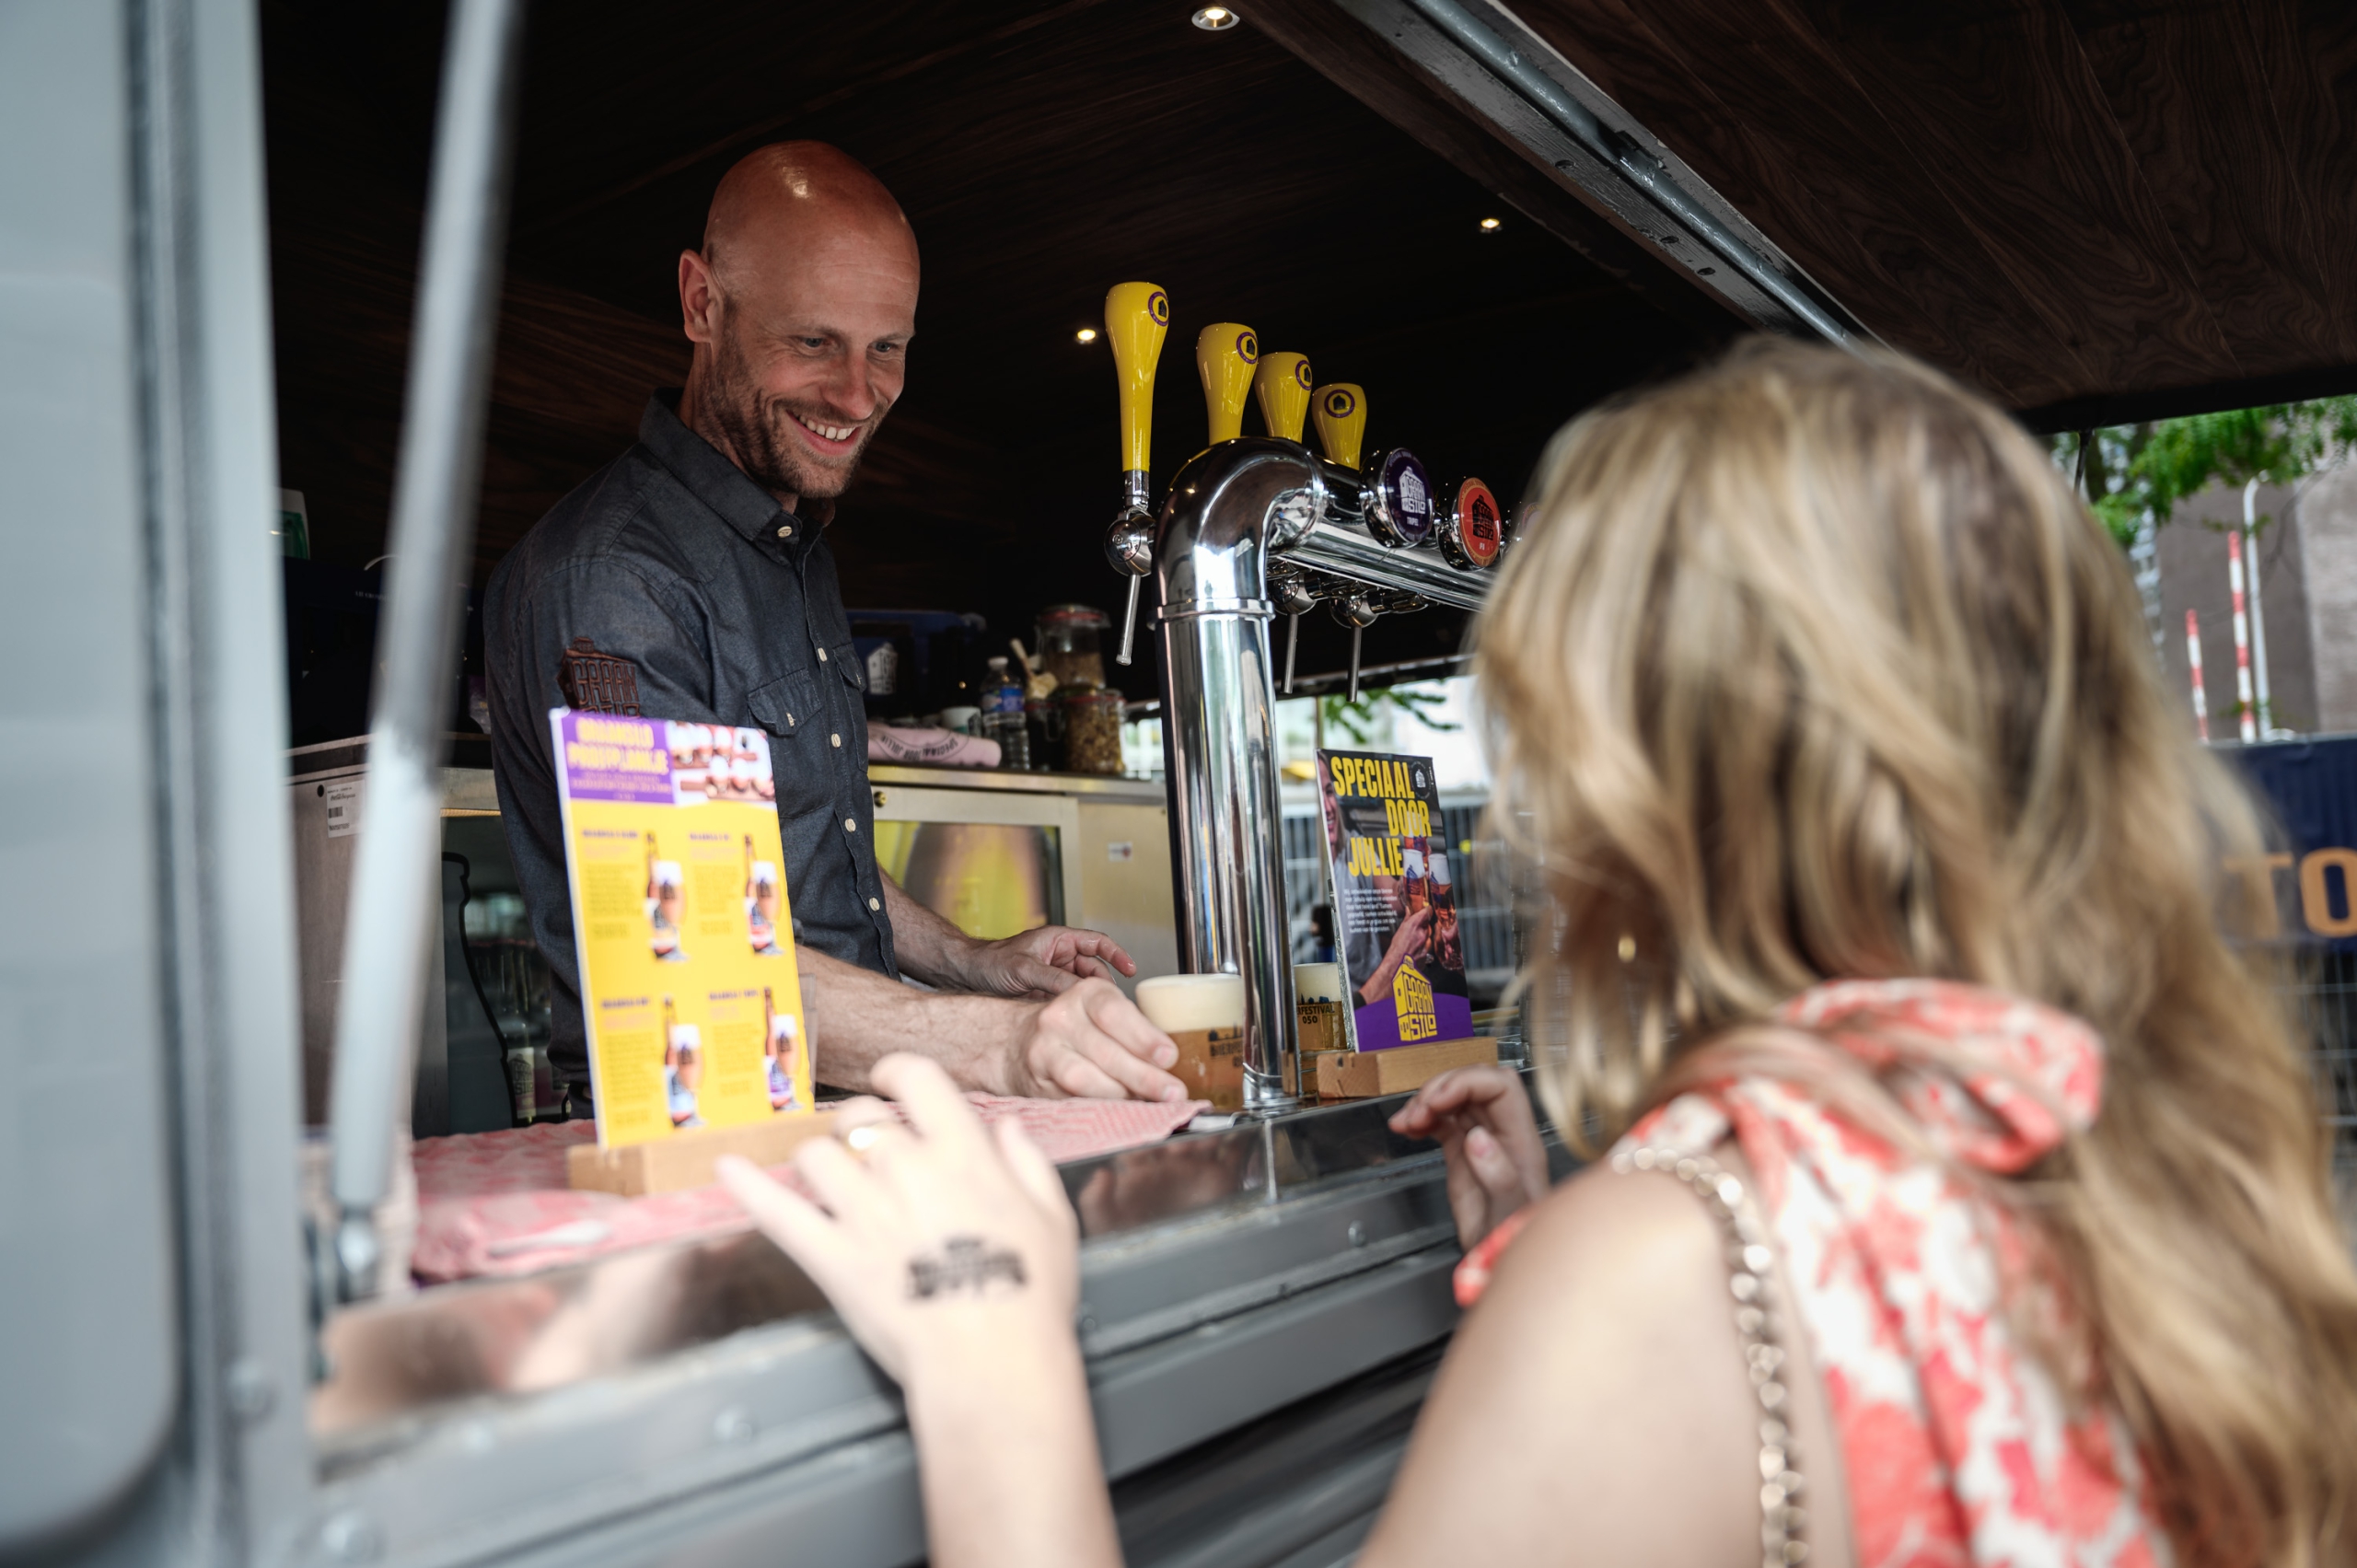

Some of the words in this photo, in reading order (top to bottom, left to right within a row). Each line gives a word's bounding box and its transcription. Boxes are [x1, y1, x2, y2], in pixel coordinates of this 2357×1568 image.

[1408, 498, 1426, 515] SILO
[1479, 526, 1494, 541] SILO
[571, 660, 640, 705] GRAAN
[1330, 756, 1415, 799] SPECIAAL
[1385, 798, 1433, 837] DOOR
[1348, 837, 1404, 877] JULLIE
[1403, 973, 1434, 1014] GRAAN
[1302, 1016, 1318, 1024] 050
[1409, 1013, 1438, 1041] SILO
